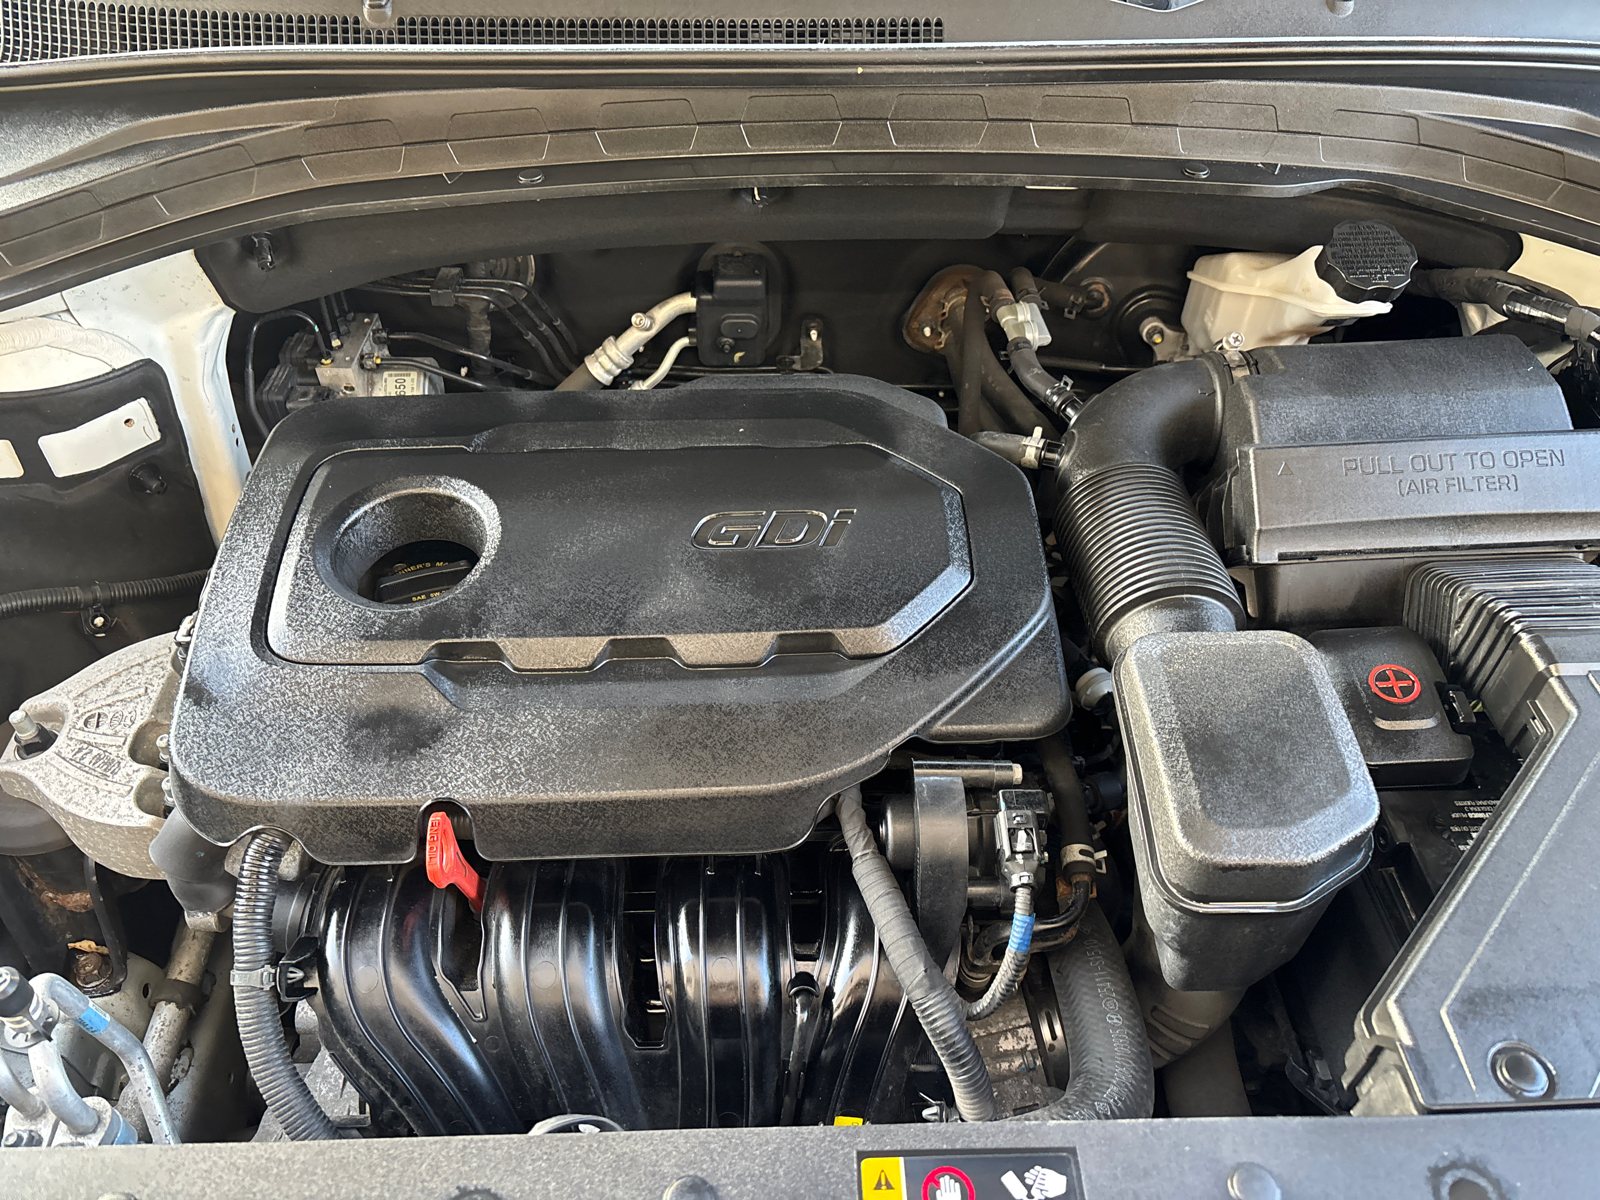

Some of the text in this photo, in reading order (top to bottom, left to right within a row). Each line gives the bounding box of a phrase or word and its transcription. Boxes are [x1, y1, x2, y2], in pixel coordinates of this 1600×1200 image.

[1342, 448, 1565, 476] PULL OUT TO OPEN
[1396, 474, 1519, 497] (AIR FILTER)
[691, 508, 857, 551] GDi
[428, 820, 441, 863] ENG OIL
